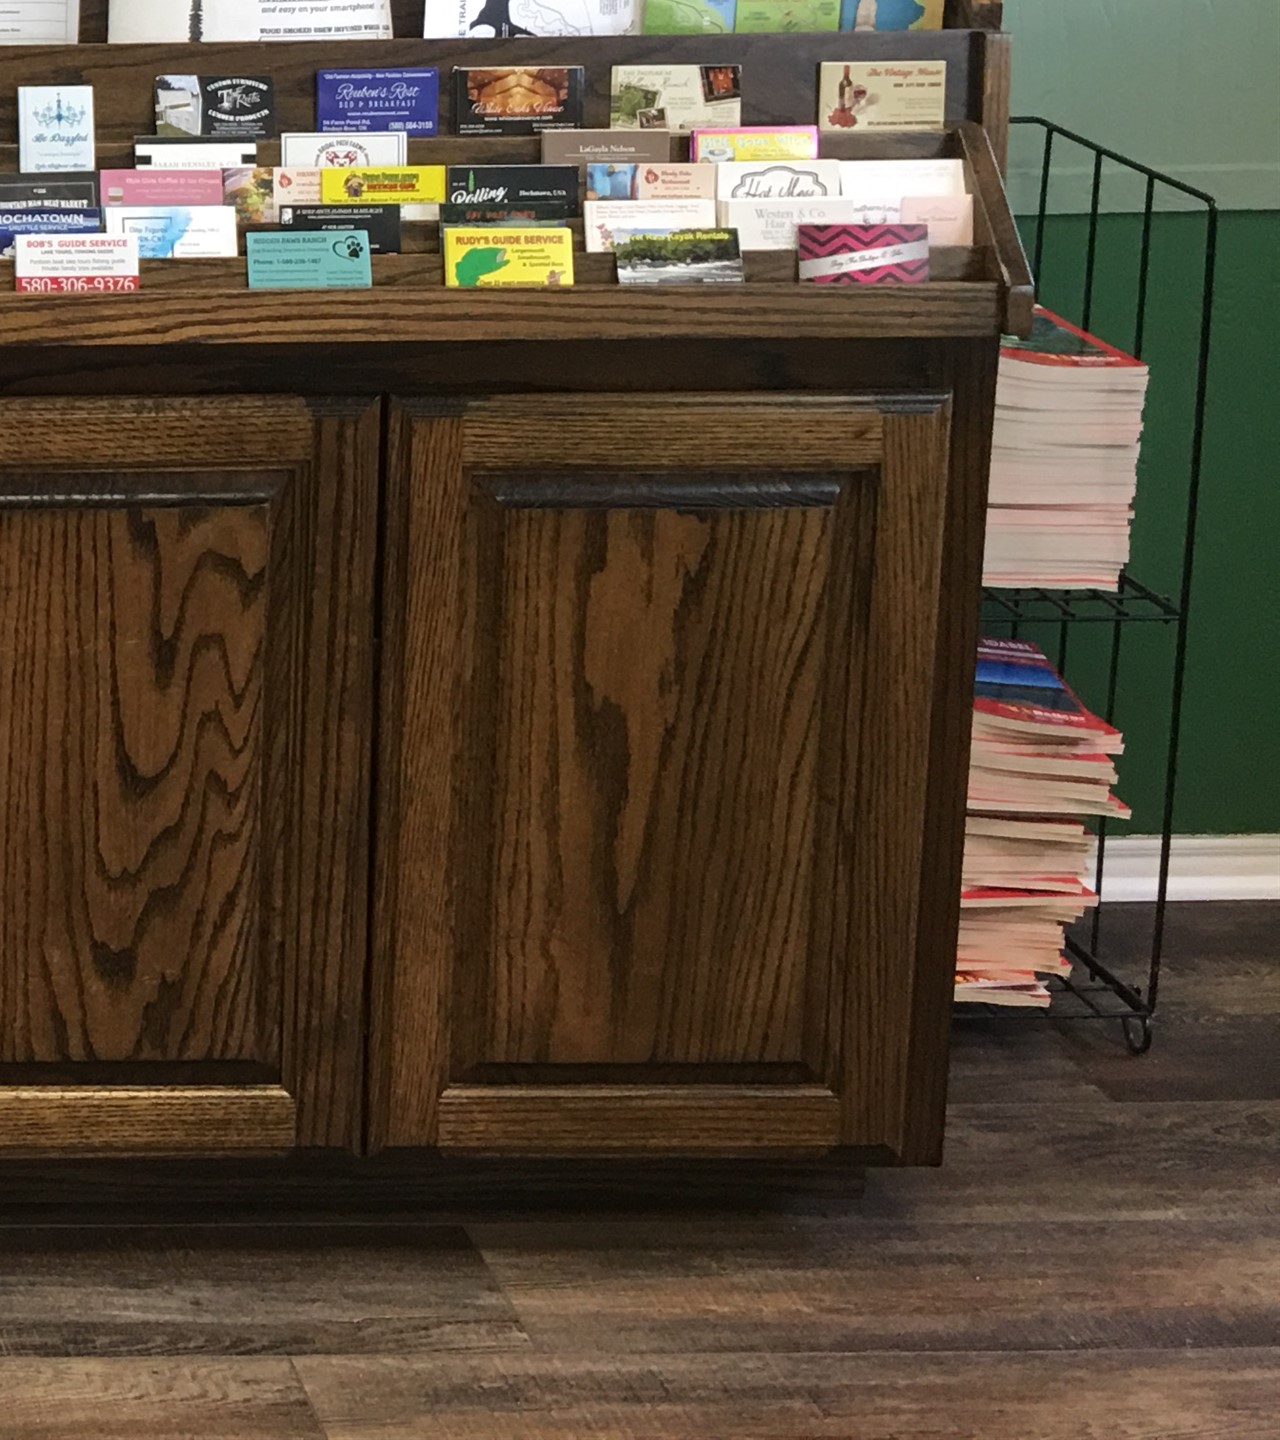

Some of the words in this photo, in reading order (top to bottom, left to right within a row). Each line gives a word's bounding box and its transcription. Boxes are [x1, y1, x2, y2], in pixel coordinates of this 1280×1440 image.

[26, 239, 53, 248] BOB'S
[58, 239, 88, 248] GUIDE
[89, 239, 128, 247] SERVICE
[456, 236, 490, 245] RUDY'S
[491, 236, 522, 245] GUIDE
[524, 235, 564, 244] SERVICE
[21, 276, 135, 292] 580-306-9376
